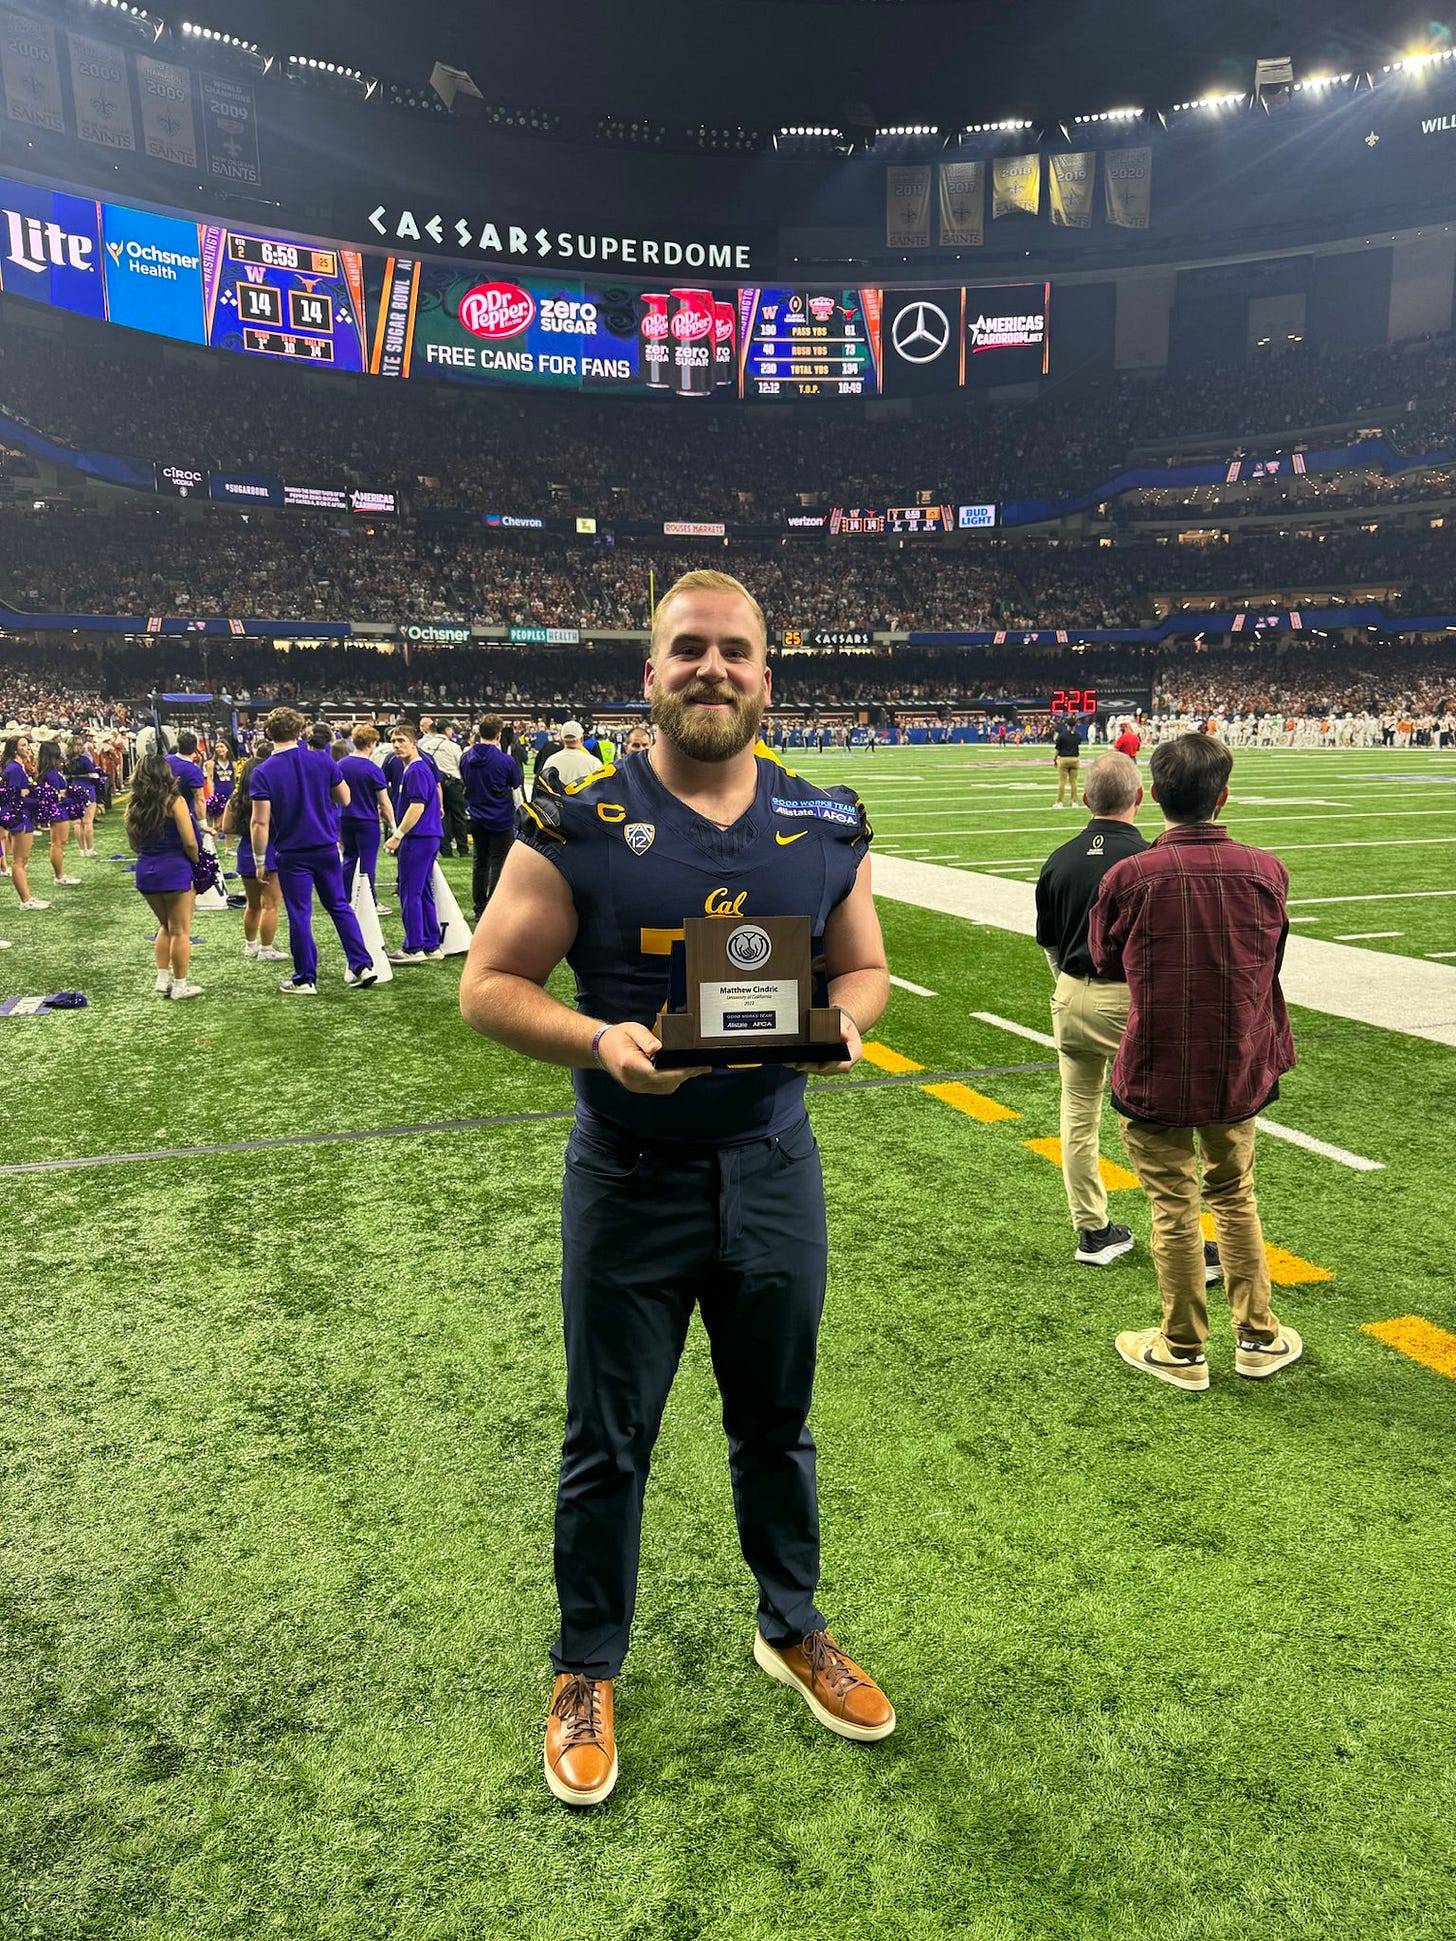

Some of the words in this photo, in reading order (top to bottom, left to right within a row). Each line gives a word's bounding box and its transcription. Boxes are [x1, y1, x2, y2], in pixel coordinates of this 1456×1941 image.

[80, 61, 121, 82] 2009
[146, 80, 185, 103] 2009
[210, 100, 248, 119] 2009
[82, 126, 132, 148] SAINTS
[150, 142, 195, 166] SAINTS
[211, 161, 256, 181] SAINTS
[1001, 167, 1031, 178] 2018
[1057, 170, 1087, 182] 2019
[1111, 167, 1145, 179] 2020
[948, 182, 977, 194] 2017
[367, 205, 552, 258] CAESARS
[557, 232, 751, 269] SUPERDOME
[126, 241, 199, 270] Ochsner
[238, 246, 245, 258] 2
[261, 243, 298, 268] 6:59
[129, 258, 178, 281] Health
[244, 265, 266, 284] W
[391, 280, 410, 310] BOWL
[487, 290, 513, 312] Dr
[249, 291, 272, 316] 14
[540, 299, 597, 321] zero
[300, 300, 323, 324] 14
[469, 293, 529, 332] Pepper
[685, 311, 701, 324] Dr
[762, 305, 778, 320] W
[540, 318, 597, 335] SUGAR
[675, 314, 710, 336] Pepper
[760, 325, 777, 336] 190
[792, 327, 811, 336] PASS
[968, 314, 1044, 334] AMERICAS
[386, 312, 406, 353] SUGAR
[283, 341, 296, 354] 10
[310, 345, 322, 358] 14
[675, 347, 709, 359] zero
[763, 344, 775, 355] 40
[426, 344, 476, 368] FREE
[481, 348, 533, 372] CANS
[539, 353, 577, 375] FOR
[582, 356, 631, 379] FANS
[675, 357, 709, 367] SUGAR
[760, 363, 777, 374] 230
[790, 365, 813, 375] TOTAL
[758, 382, 780, 393] 12:12
[172, 478, 194, 487] VODKA
[349, 490, 395, 504] AMERICAS
[966, 508, 988, 518] BUD
[501, 515, 542, 528] Chevron
[788, 515, 823, 526] verizon
[961, 516, 992, 526] LIGHT
[693, 525, 724, 535] MARKETS
[408, 625, 470, 642] Ochsner
[511, 630, 546, 641] PEOPLES
[548, 630, 578, 642] HEALTH
[785, 631, 801, 645] 25
[815, 633, 869, 644] CAESARS
[1051, 690, 1096, 713] 2:26
[597, 803, 626, 822] C
[800, 799, 832, 807] WORKS
[834, 802, 856, 813] TEAM
[632, 836, 647, 848] 12
[704, 887, 749, 916] Cal
[719, 986, 752, 994] Matthew
[753, 985, 779, 993] Cindric
